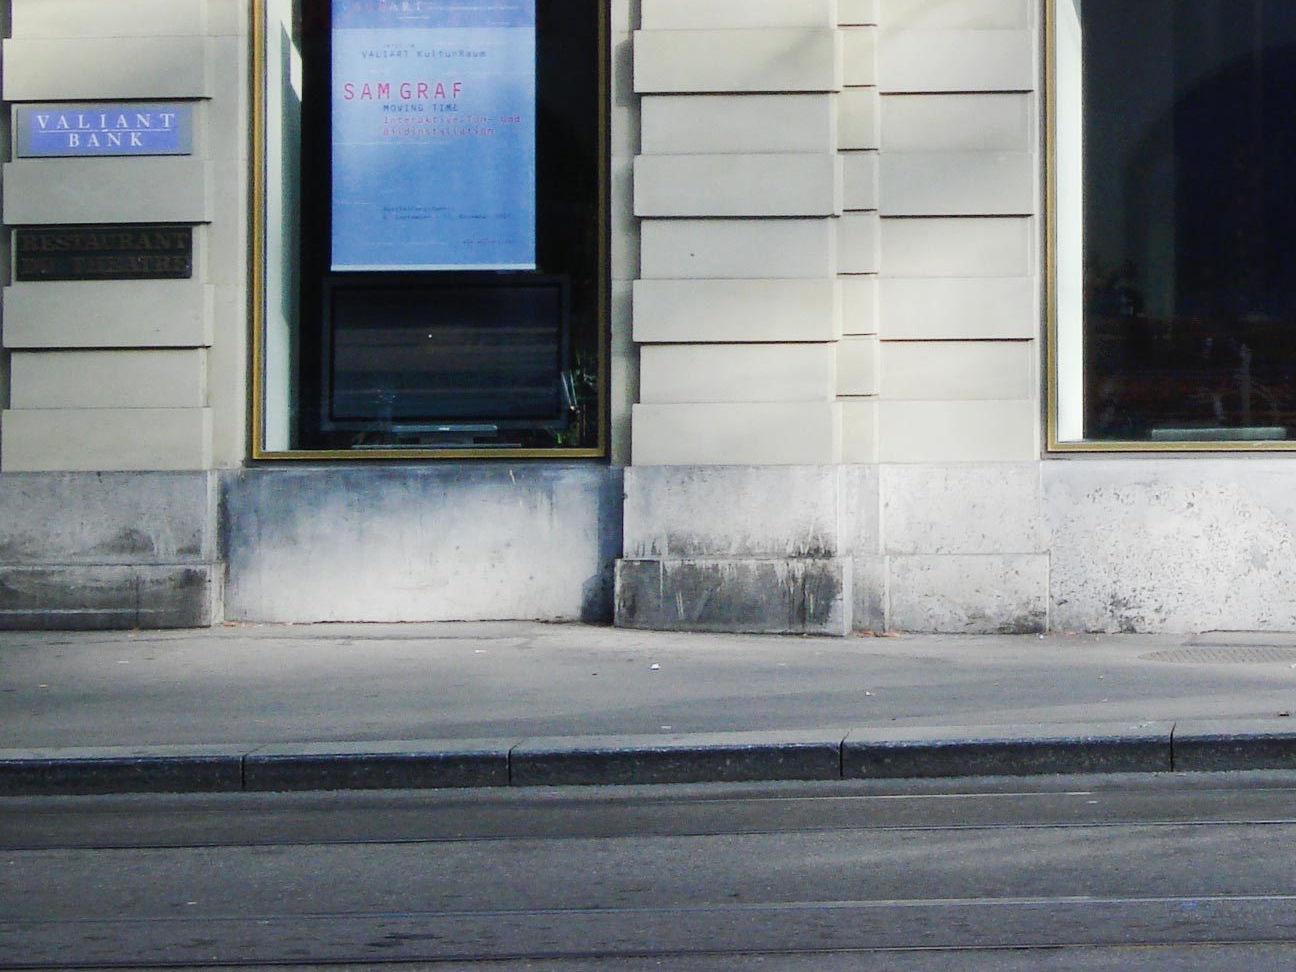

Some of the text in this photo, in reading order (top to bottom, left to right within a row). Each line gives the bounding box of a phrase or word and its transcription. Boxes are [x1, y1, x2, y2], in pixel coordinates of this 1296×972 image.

[343, 81, 463, 100] SAM GRAF
[383, 103, 459, 112] MOVING TIME
[36, 113, 176, 129] VALIANT
[500, 114, 521, 124] und
[68, 131, 144, 147] BANK
[20, 233, 188, 250] RESTAURANT
